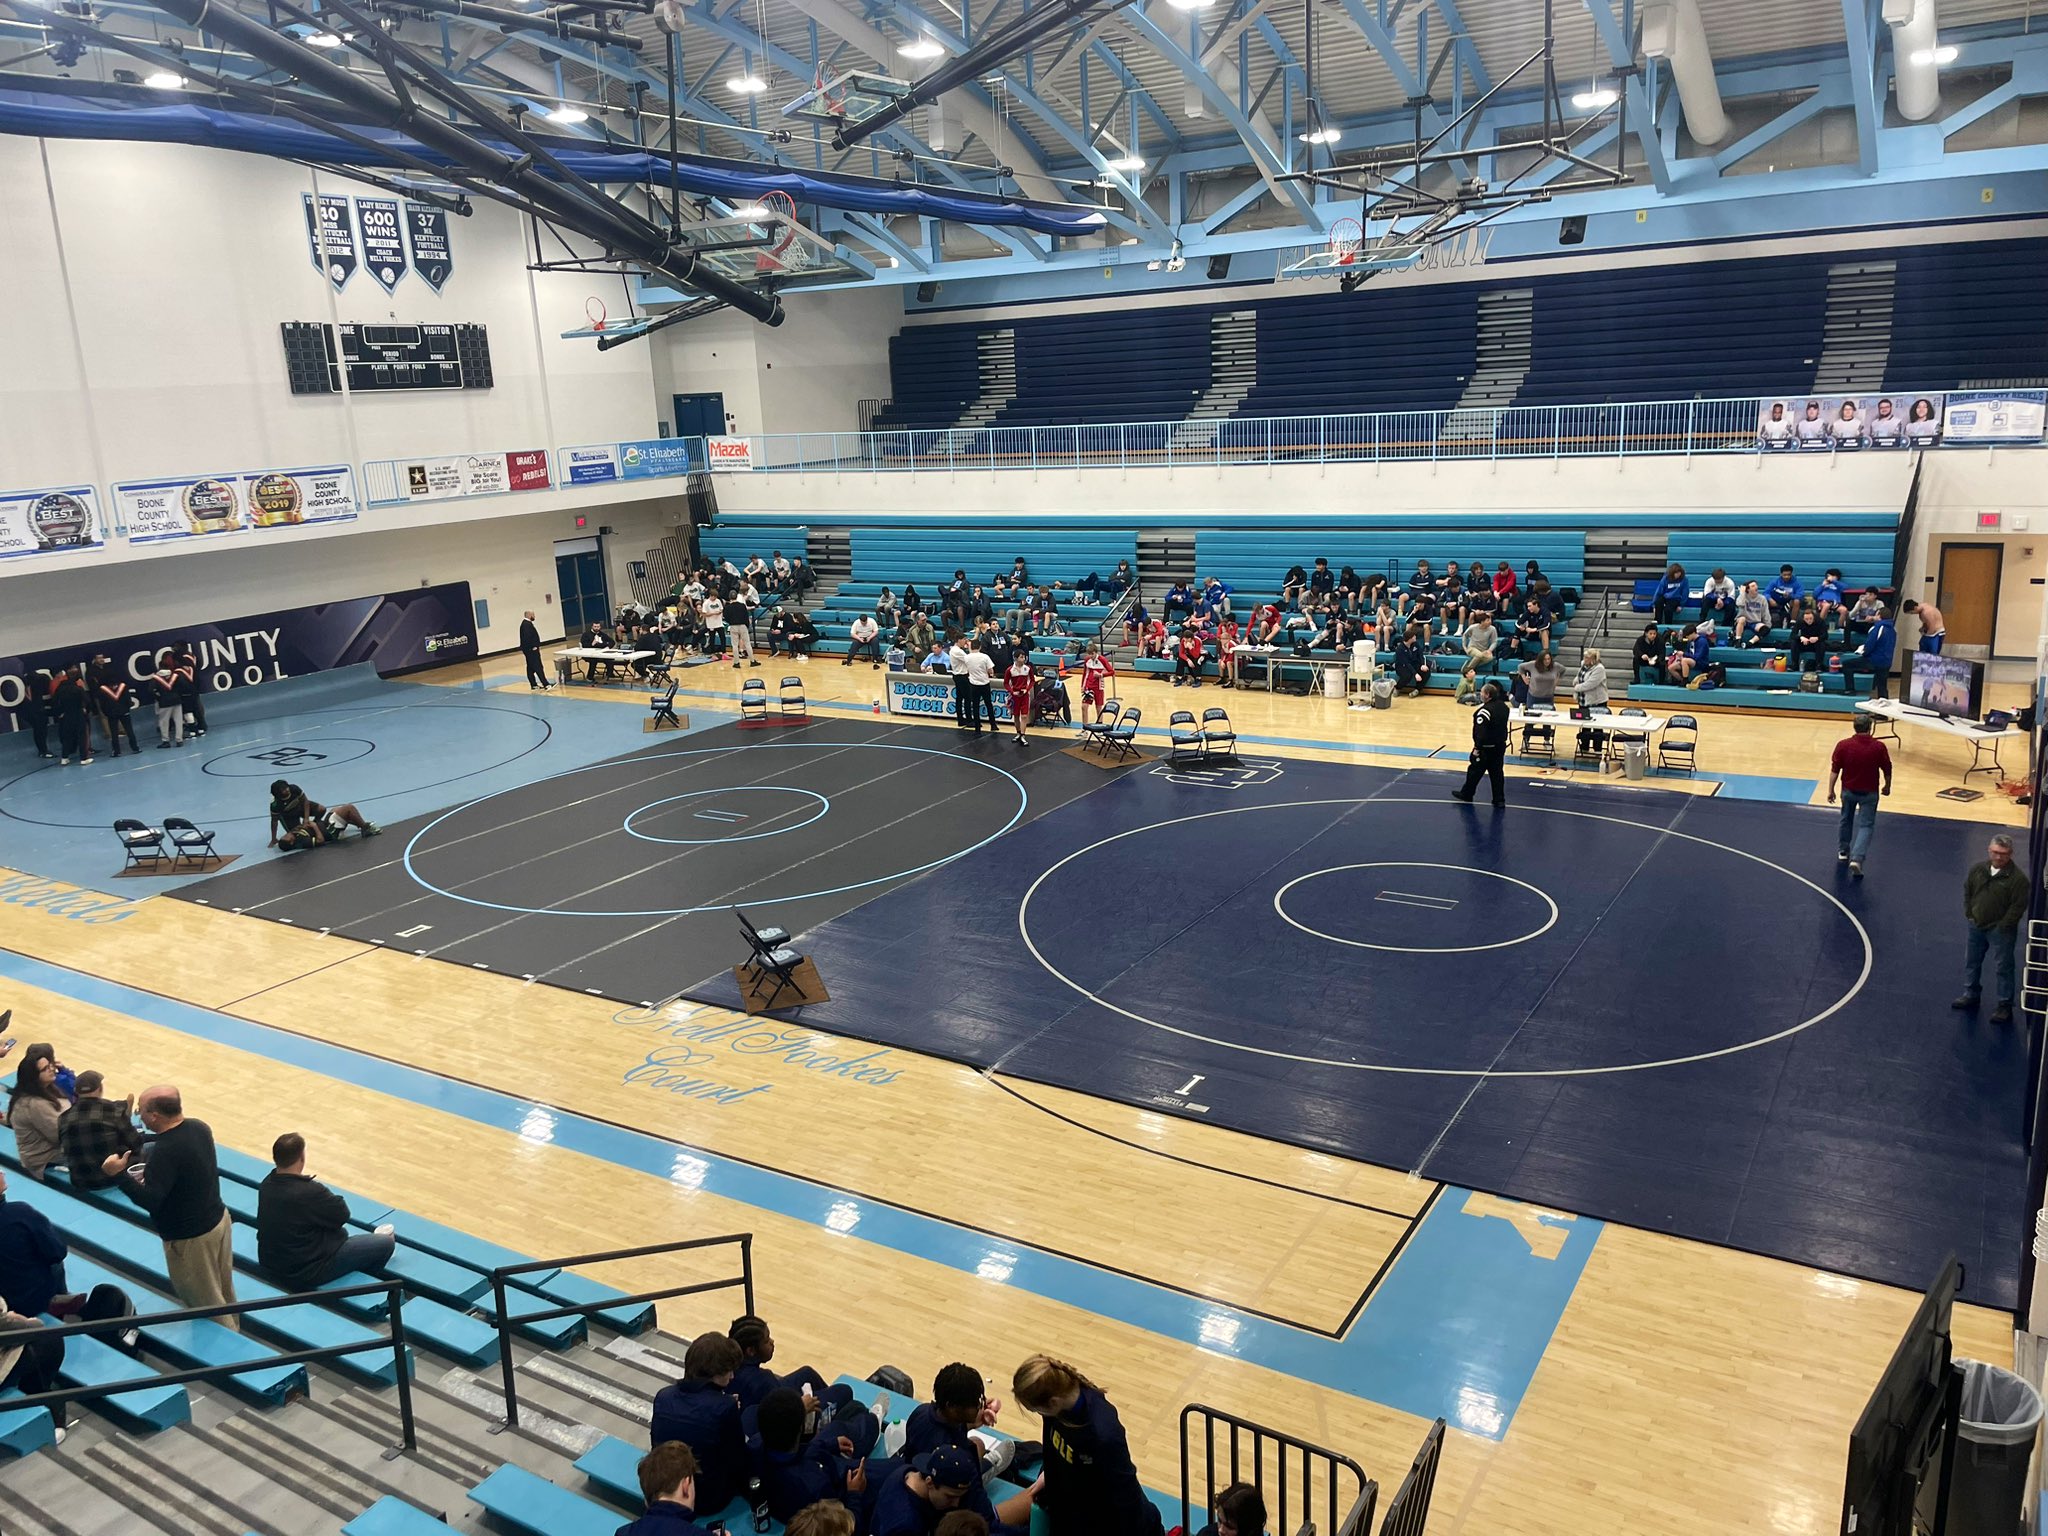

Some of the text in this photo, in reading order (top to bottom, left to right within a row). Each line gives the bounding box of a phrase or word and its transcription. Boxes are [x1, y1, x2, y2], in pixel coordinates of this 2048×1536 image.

[364, 211, 394, 226] 600
[417, 213, 435, 226] 37
[365, 226, 397, 237] WINS
[340, 326, 355, 334] OME
[423, 326, 450, 335] VISITOR
[639, 446, 685, 459] St. Elizabeth
[710, 442, 749, 457] Mazak
[522, 468, 546, 481] REBELS!
[260, 485, 287, 495] BEST
[315, 481, 337, 489] BOONE
[314, 489, 340, 498] COUNTY
[137, 498, 165, 509] BOONE
[195, 496, 221, 504] BEST
[265, 499, 289, 509] 2019
[325, 497, 351, 505] SCHOOL
[40, 509, 74, 519] BEST
[137, 510, 170, 520] COUNTY
[130, 521, 182, 533] HIGH SCHOOL
[894, 682, 948, 698] BOONE
[902, 698, 943, 712] HIGH
[621, 1046, 774, 1105] Court
